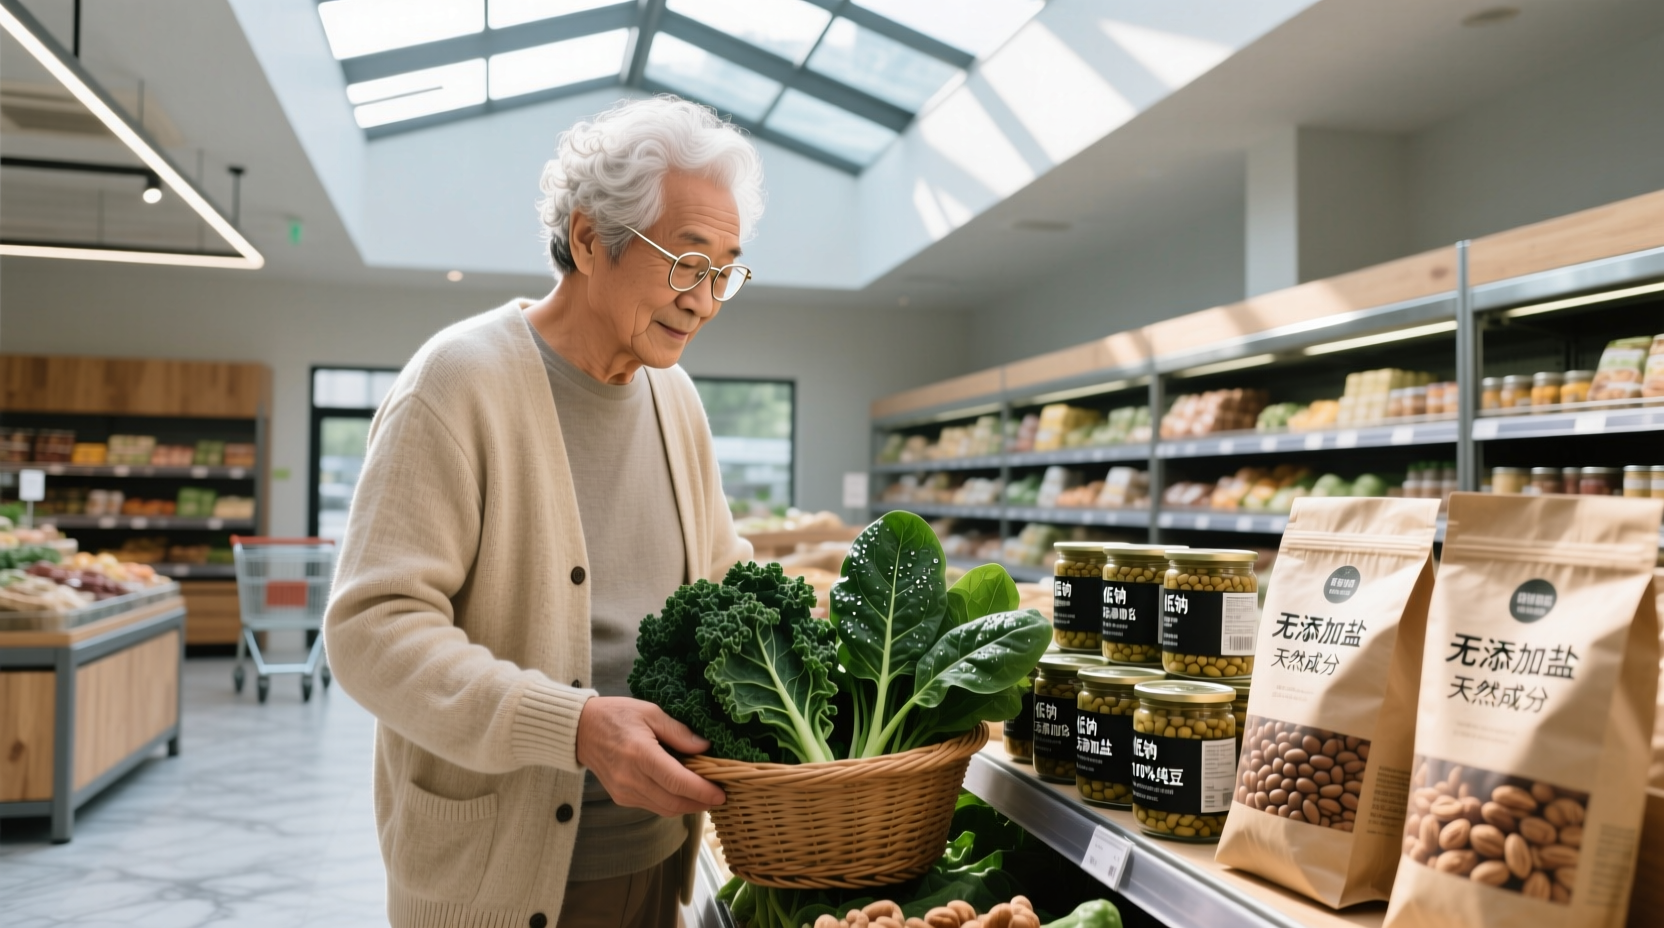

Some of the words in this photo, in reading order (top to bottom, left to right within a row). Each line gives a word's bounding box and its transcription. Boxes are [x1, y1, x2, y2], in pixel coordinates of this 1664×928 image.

[1272, 612, 1367, 647] 无添加盐
[1271, 648, 1340, 675] 天然成分
[1445, 632, 1579, 680] 无添加盐
[1447, 674, 1549, 713] 天然成分
